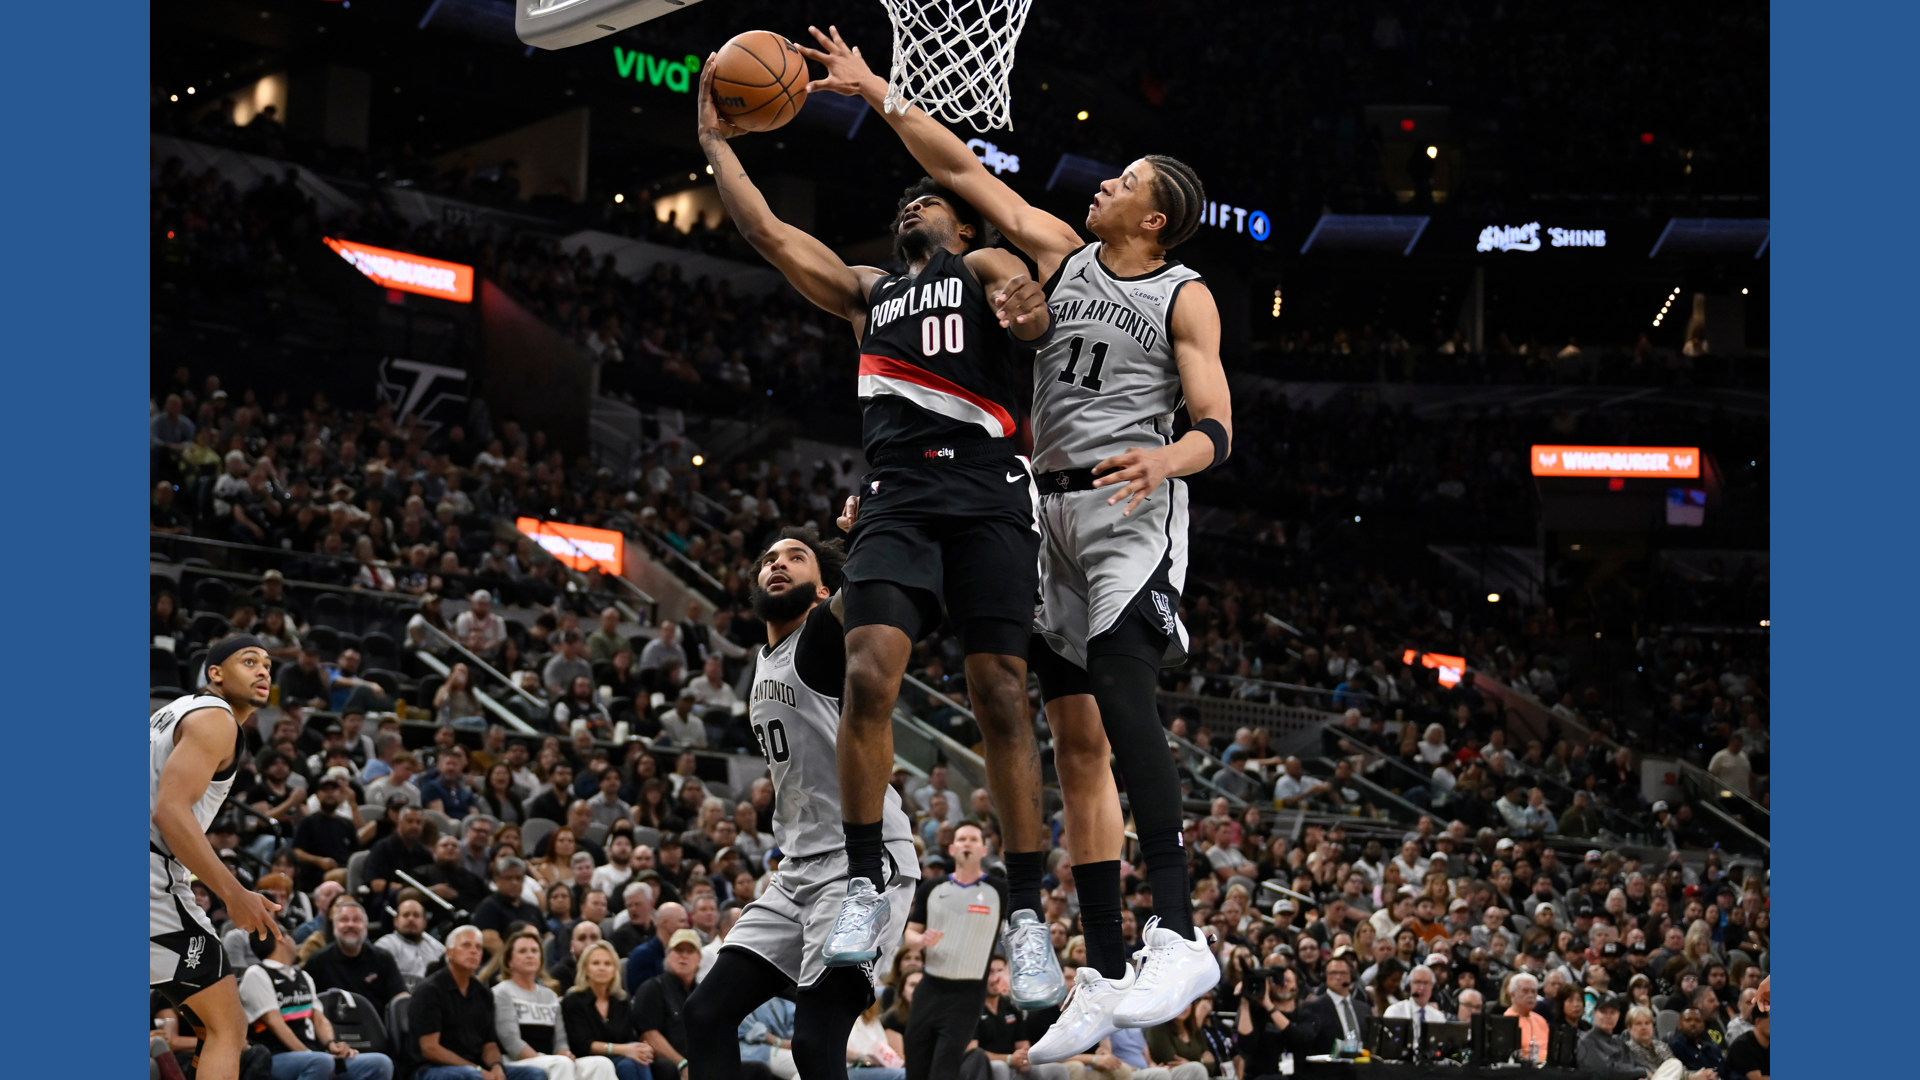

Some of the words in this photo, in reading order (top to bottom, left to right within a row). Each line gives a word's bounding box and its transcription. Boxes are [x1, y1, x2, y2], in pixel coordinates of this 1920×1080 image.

[613, 46, 689, 93] viva
[966, 138, 1019, 175] Clips
[1477, 222, 1541, 252] Shiner
[870, 277, 963, 335] PORTLAND
[1134, 290, 1160, 302] LEDGER
[921, 313, 964, 357] 00
[1080, 299, 1159, 354] ANTONIO
[1057, 334, 1110, 393] 11
[924, 447, 955, 459] ripcity
[1562, 452, 1671, 471] WHATABURGER
[753, 679, 798, 709] ANTONIO
